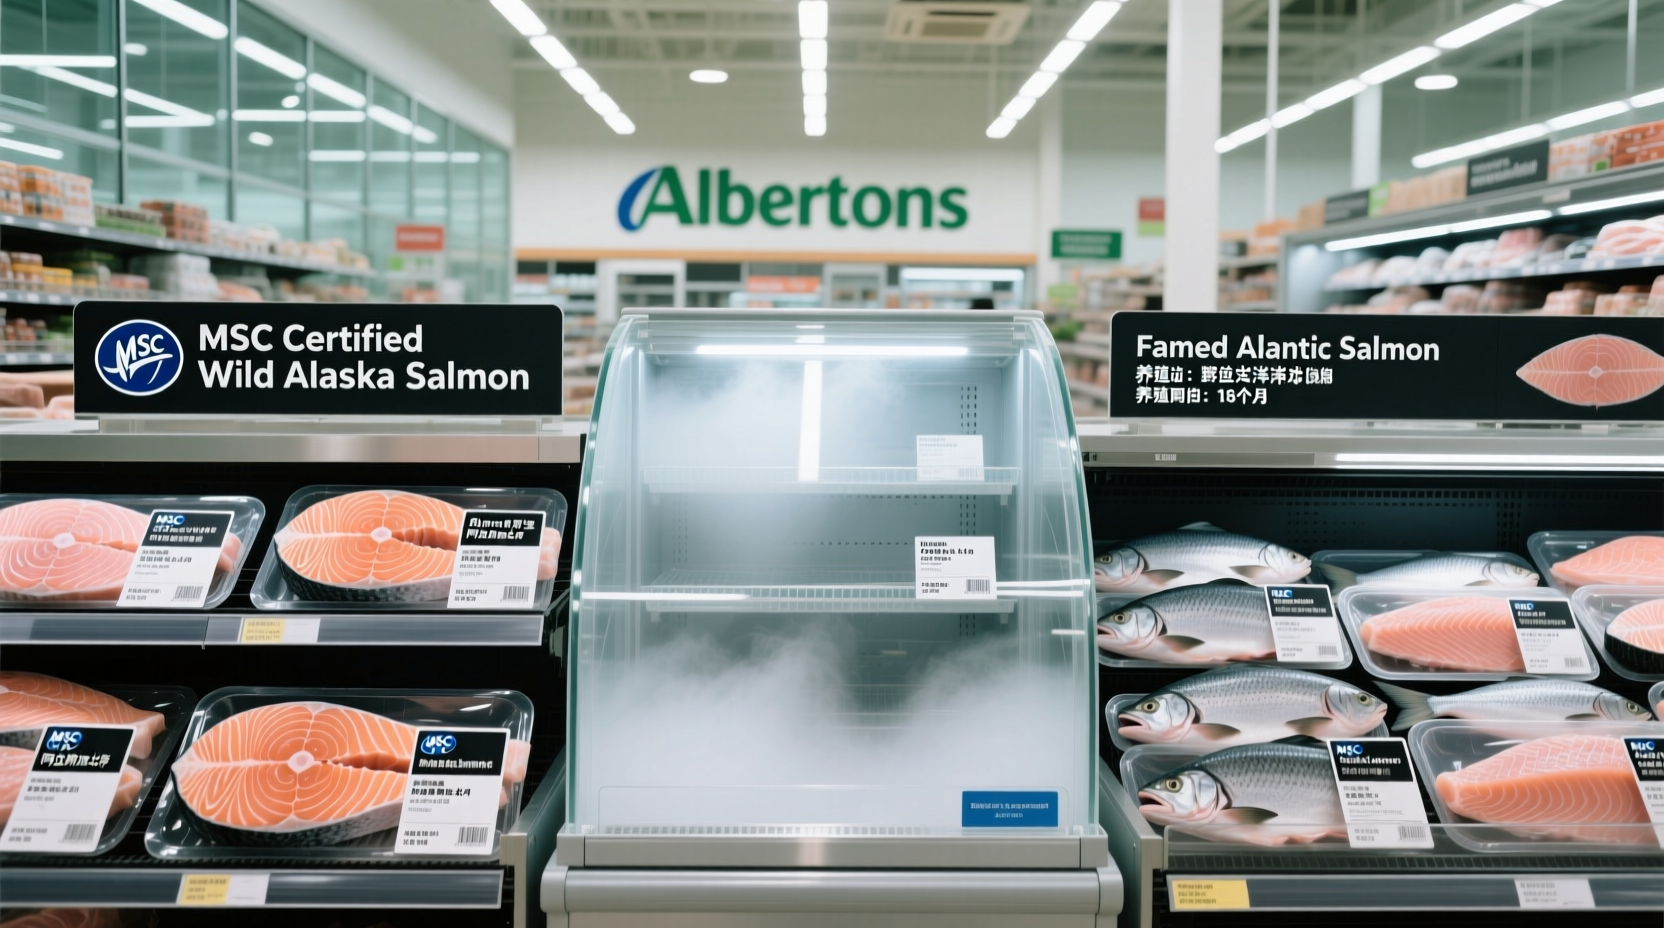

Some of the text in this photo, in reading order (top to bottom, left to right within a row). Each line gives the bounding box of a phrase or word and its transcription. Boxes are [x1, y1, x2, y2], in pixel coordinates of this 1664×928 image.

[618, 166, 968, 231] Albertons
[200, 323, 423, 352] MSC Certified
[1137, 334, 1440, 361] Famed Alantic Salmon
[109, 333, 168, 381] MSC
[198, 360, 529, 390] Wild Alaska Salmon
